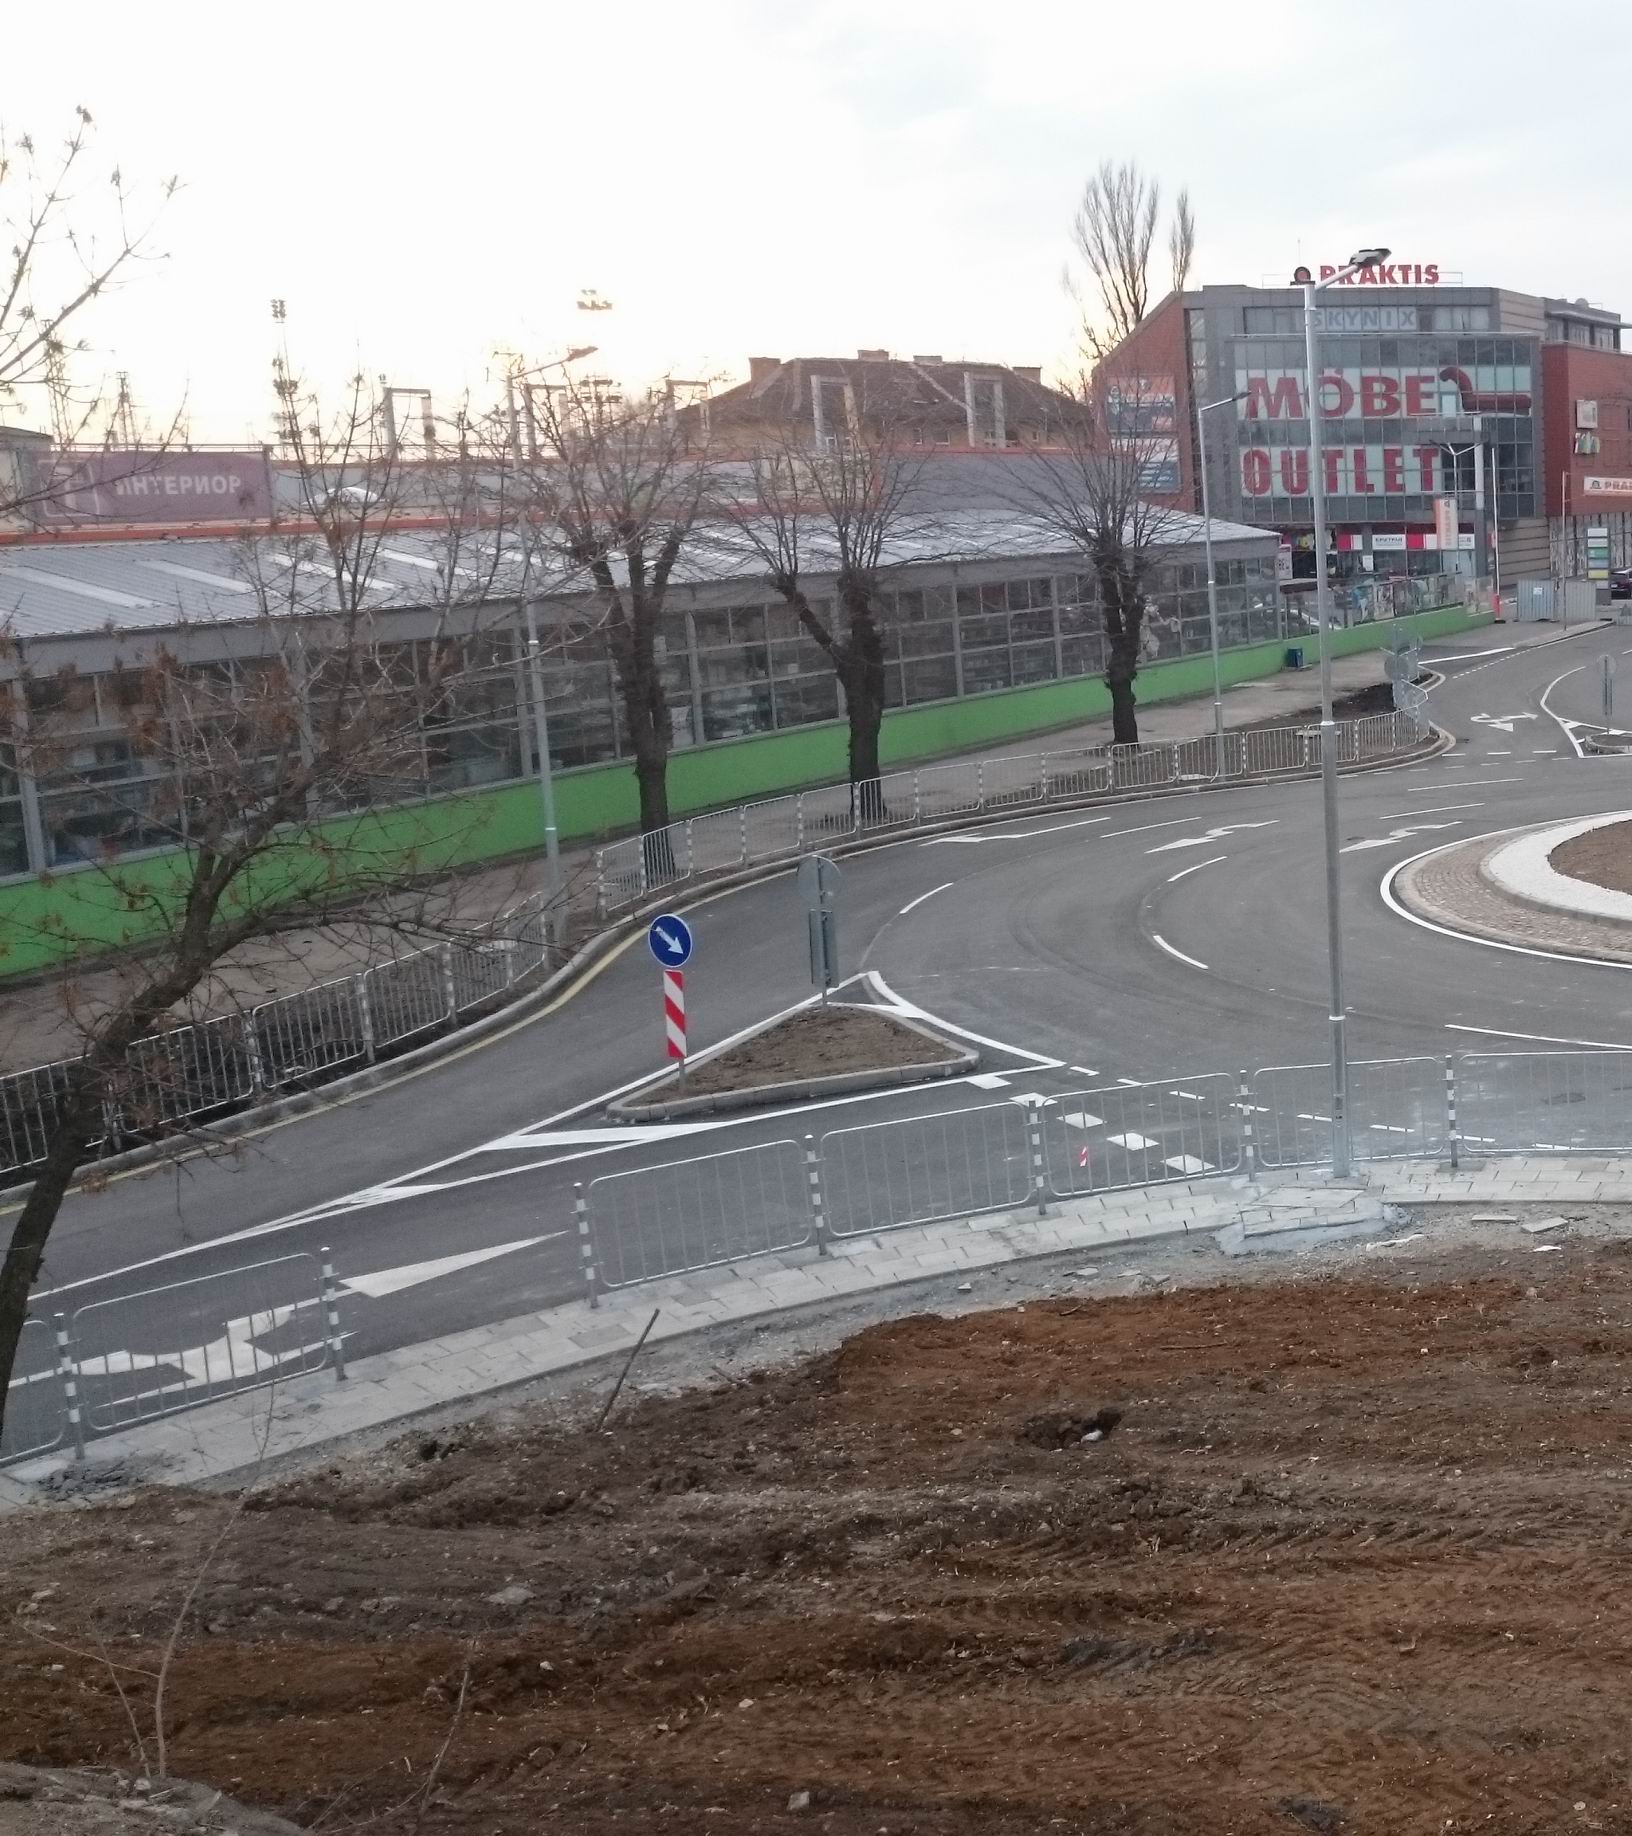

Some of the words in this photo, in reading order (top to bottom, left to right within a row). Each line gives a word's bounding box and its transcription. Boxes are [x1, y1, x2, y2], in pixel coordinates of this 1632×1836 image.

[1320, 264, 1440, 285] PRAKTIS
[1243, 448, 1440, 496] OUTLET
[116, 475, 241, 497] ИНТЕРИОР
